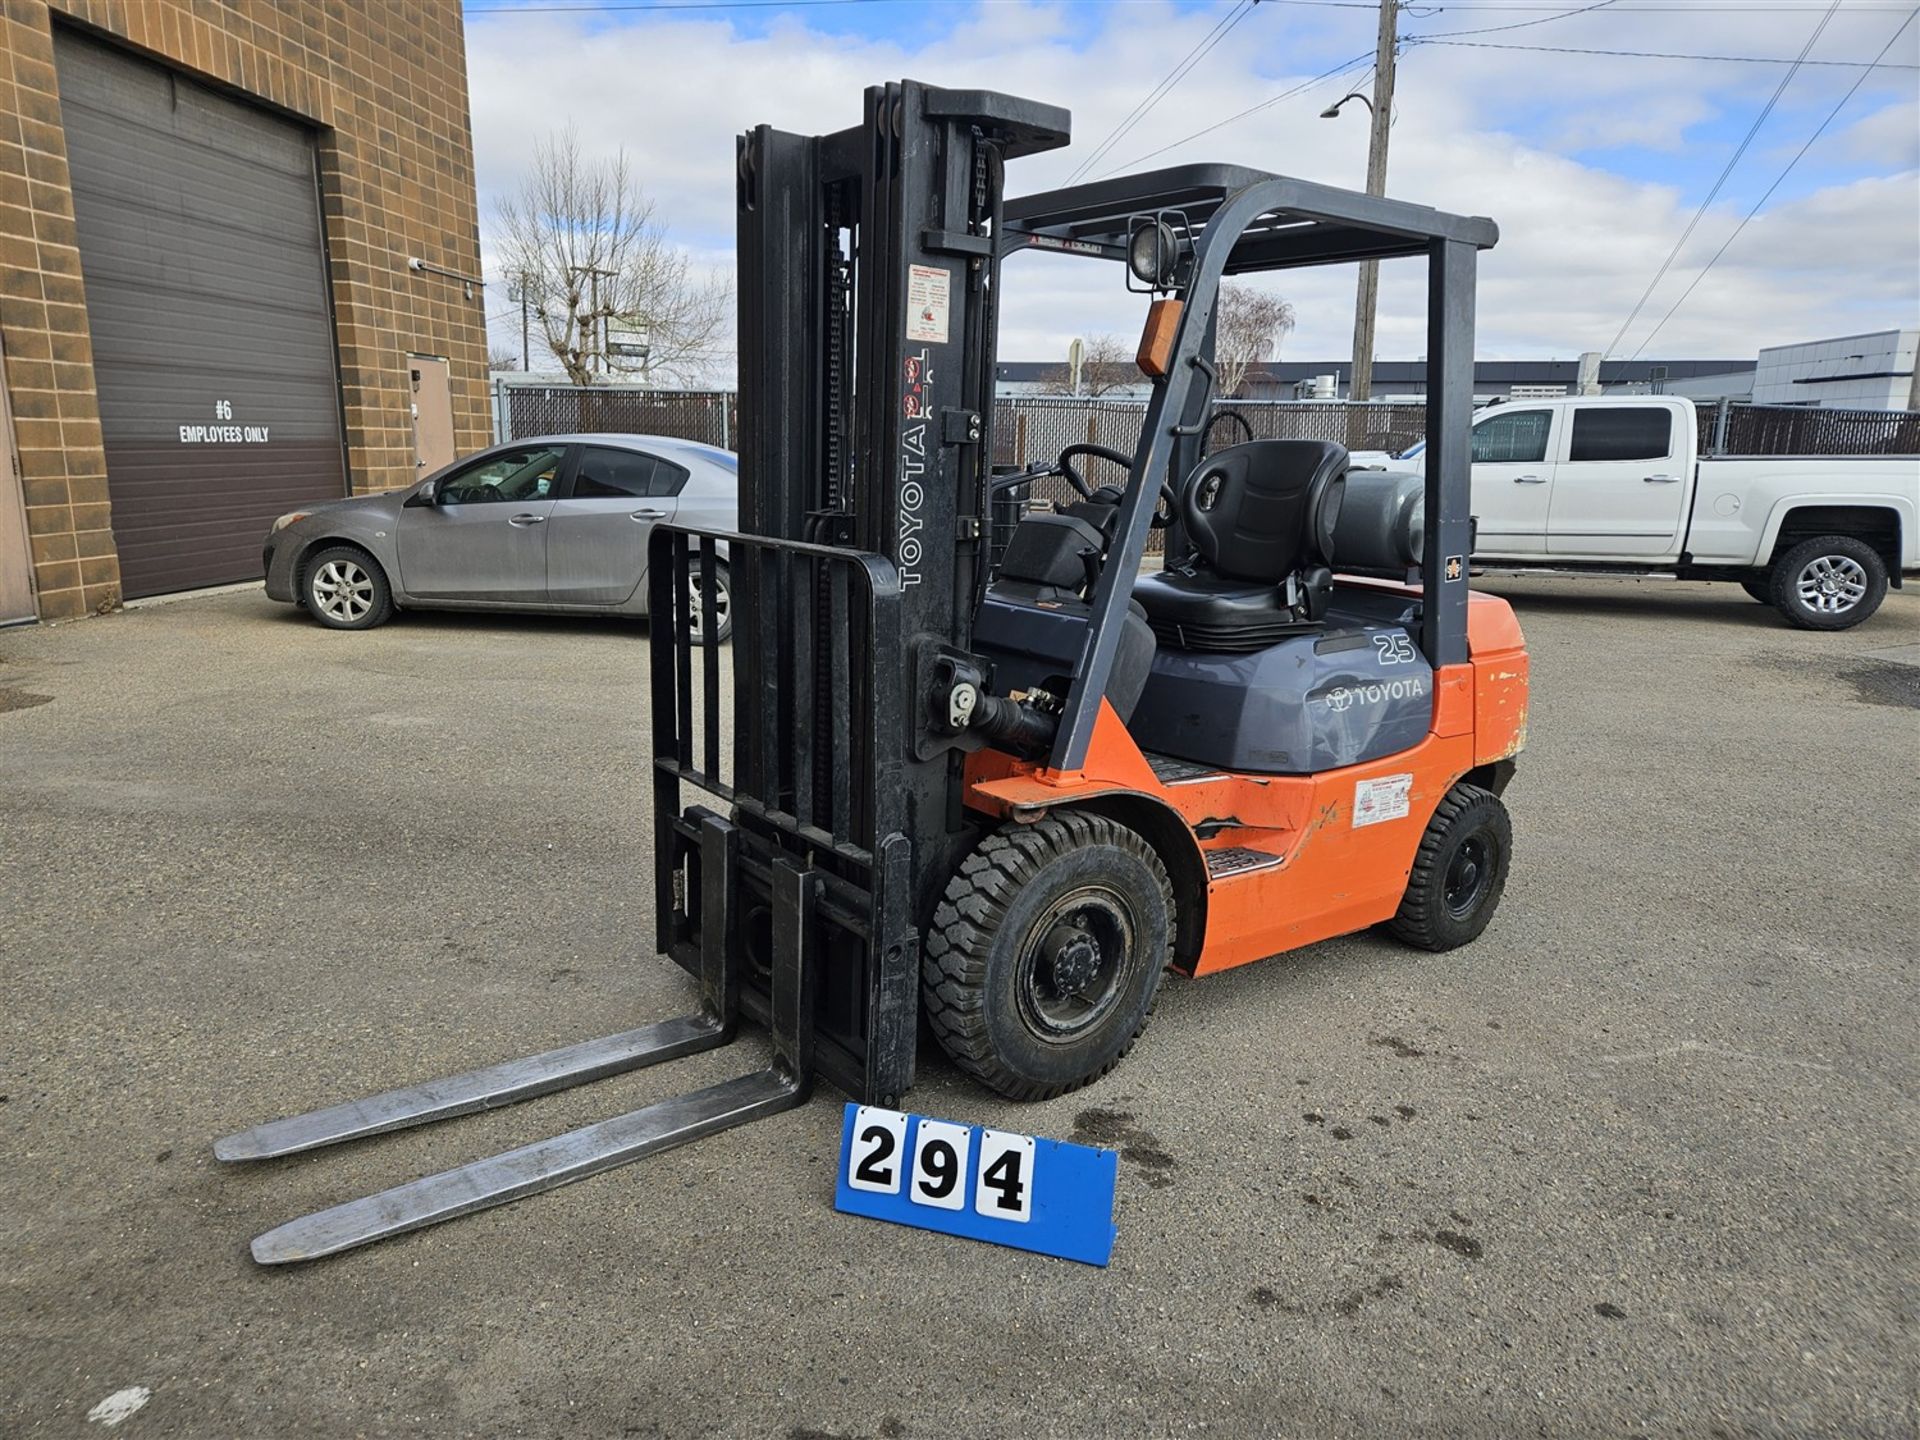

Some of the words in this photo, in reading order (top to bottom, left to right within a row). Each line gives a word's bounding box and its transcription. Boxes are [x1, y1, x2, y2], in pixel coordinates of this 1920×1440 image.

[216, 400, 232, 420] #6
[179, 426, 243, 443] EMPLOYEES
[244, 426, 269, 443] ONLY
[899, 423, 927, 593] TOYOTA
[1372, 633, 1416, 666] 25
[1353, 679, 1424, 706] TOYOTA
[855, 1125, 1024, 1212] 294
